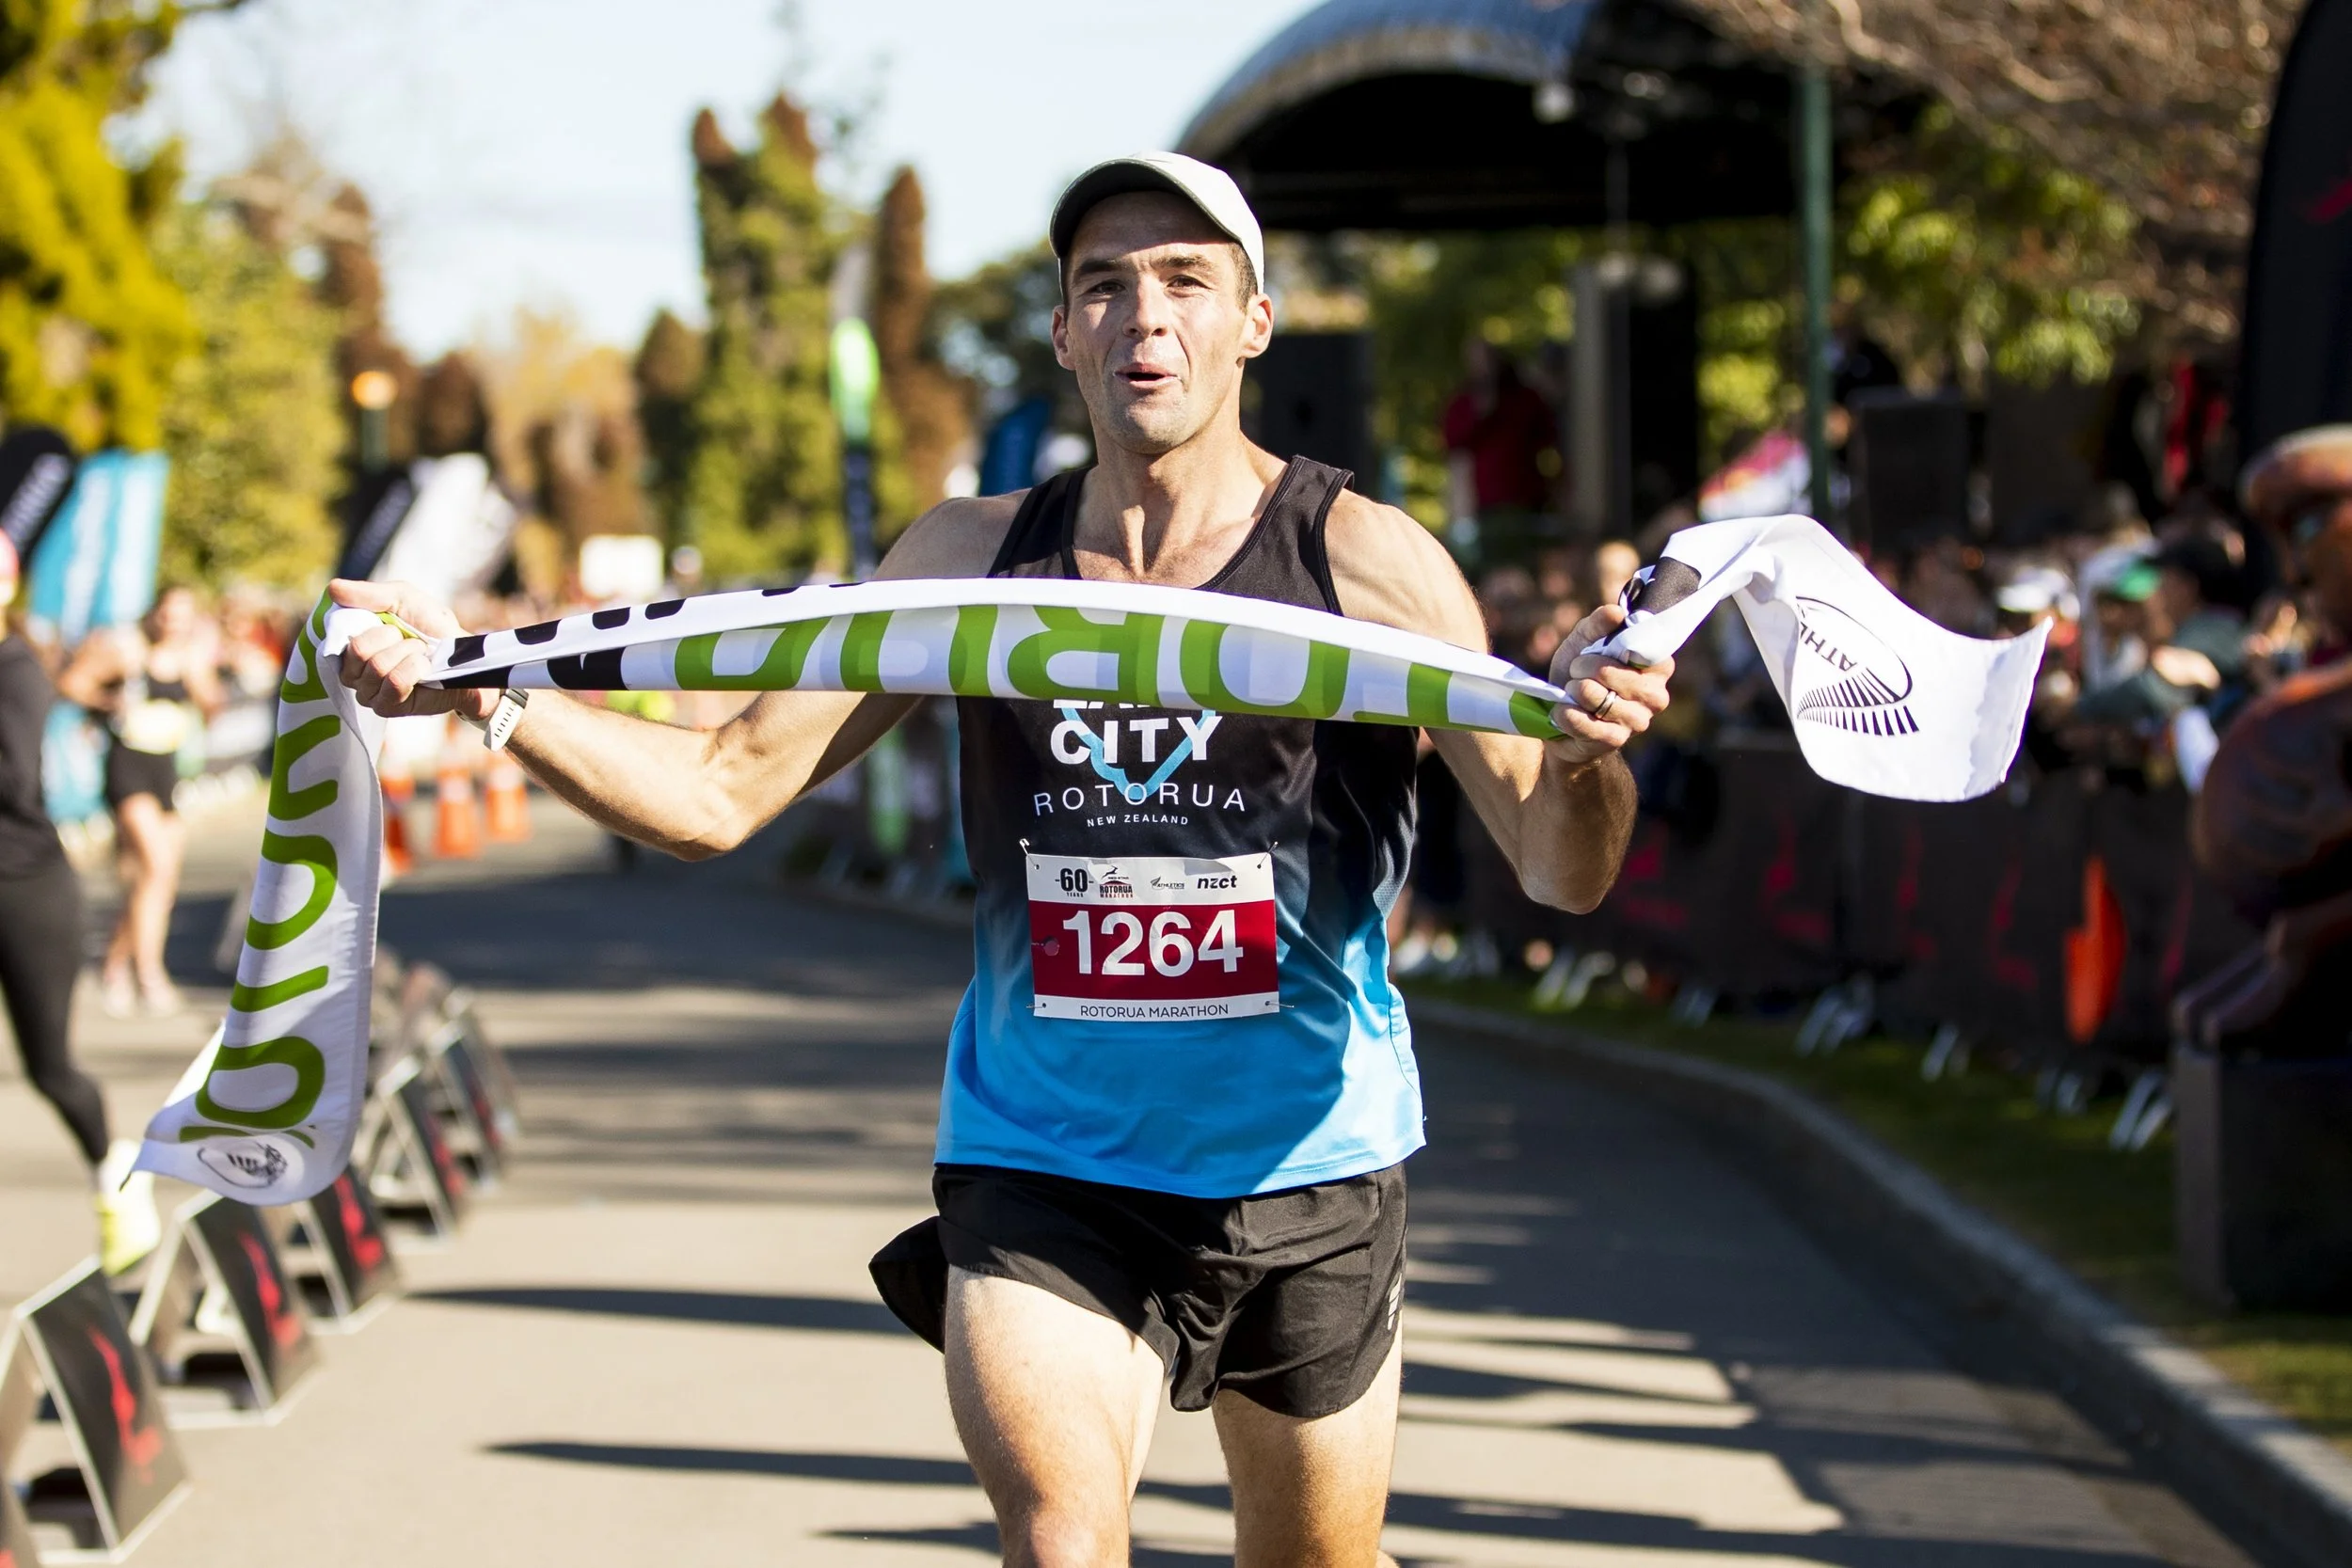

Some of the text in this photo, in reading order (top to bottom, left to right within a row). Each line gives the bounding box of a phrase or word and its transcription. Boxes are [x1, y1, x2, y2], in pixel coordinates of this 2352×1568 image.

[1050, 716, 1223, 765] CITY
[1033, 783, 1246, 816] ROTORUA
[1087, 814, 1188, 828] NEW ZEALAND
[1099, 885, 1133, 894] ROTORUA
[1197, 875, 1237, 889] nzct
[1063, 909, 1244, 977] 1264
[1080, 1004, 1229, 1019] ROTORUA MARATHON
